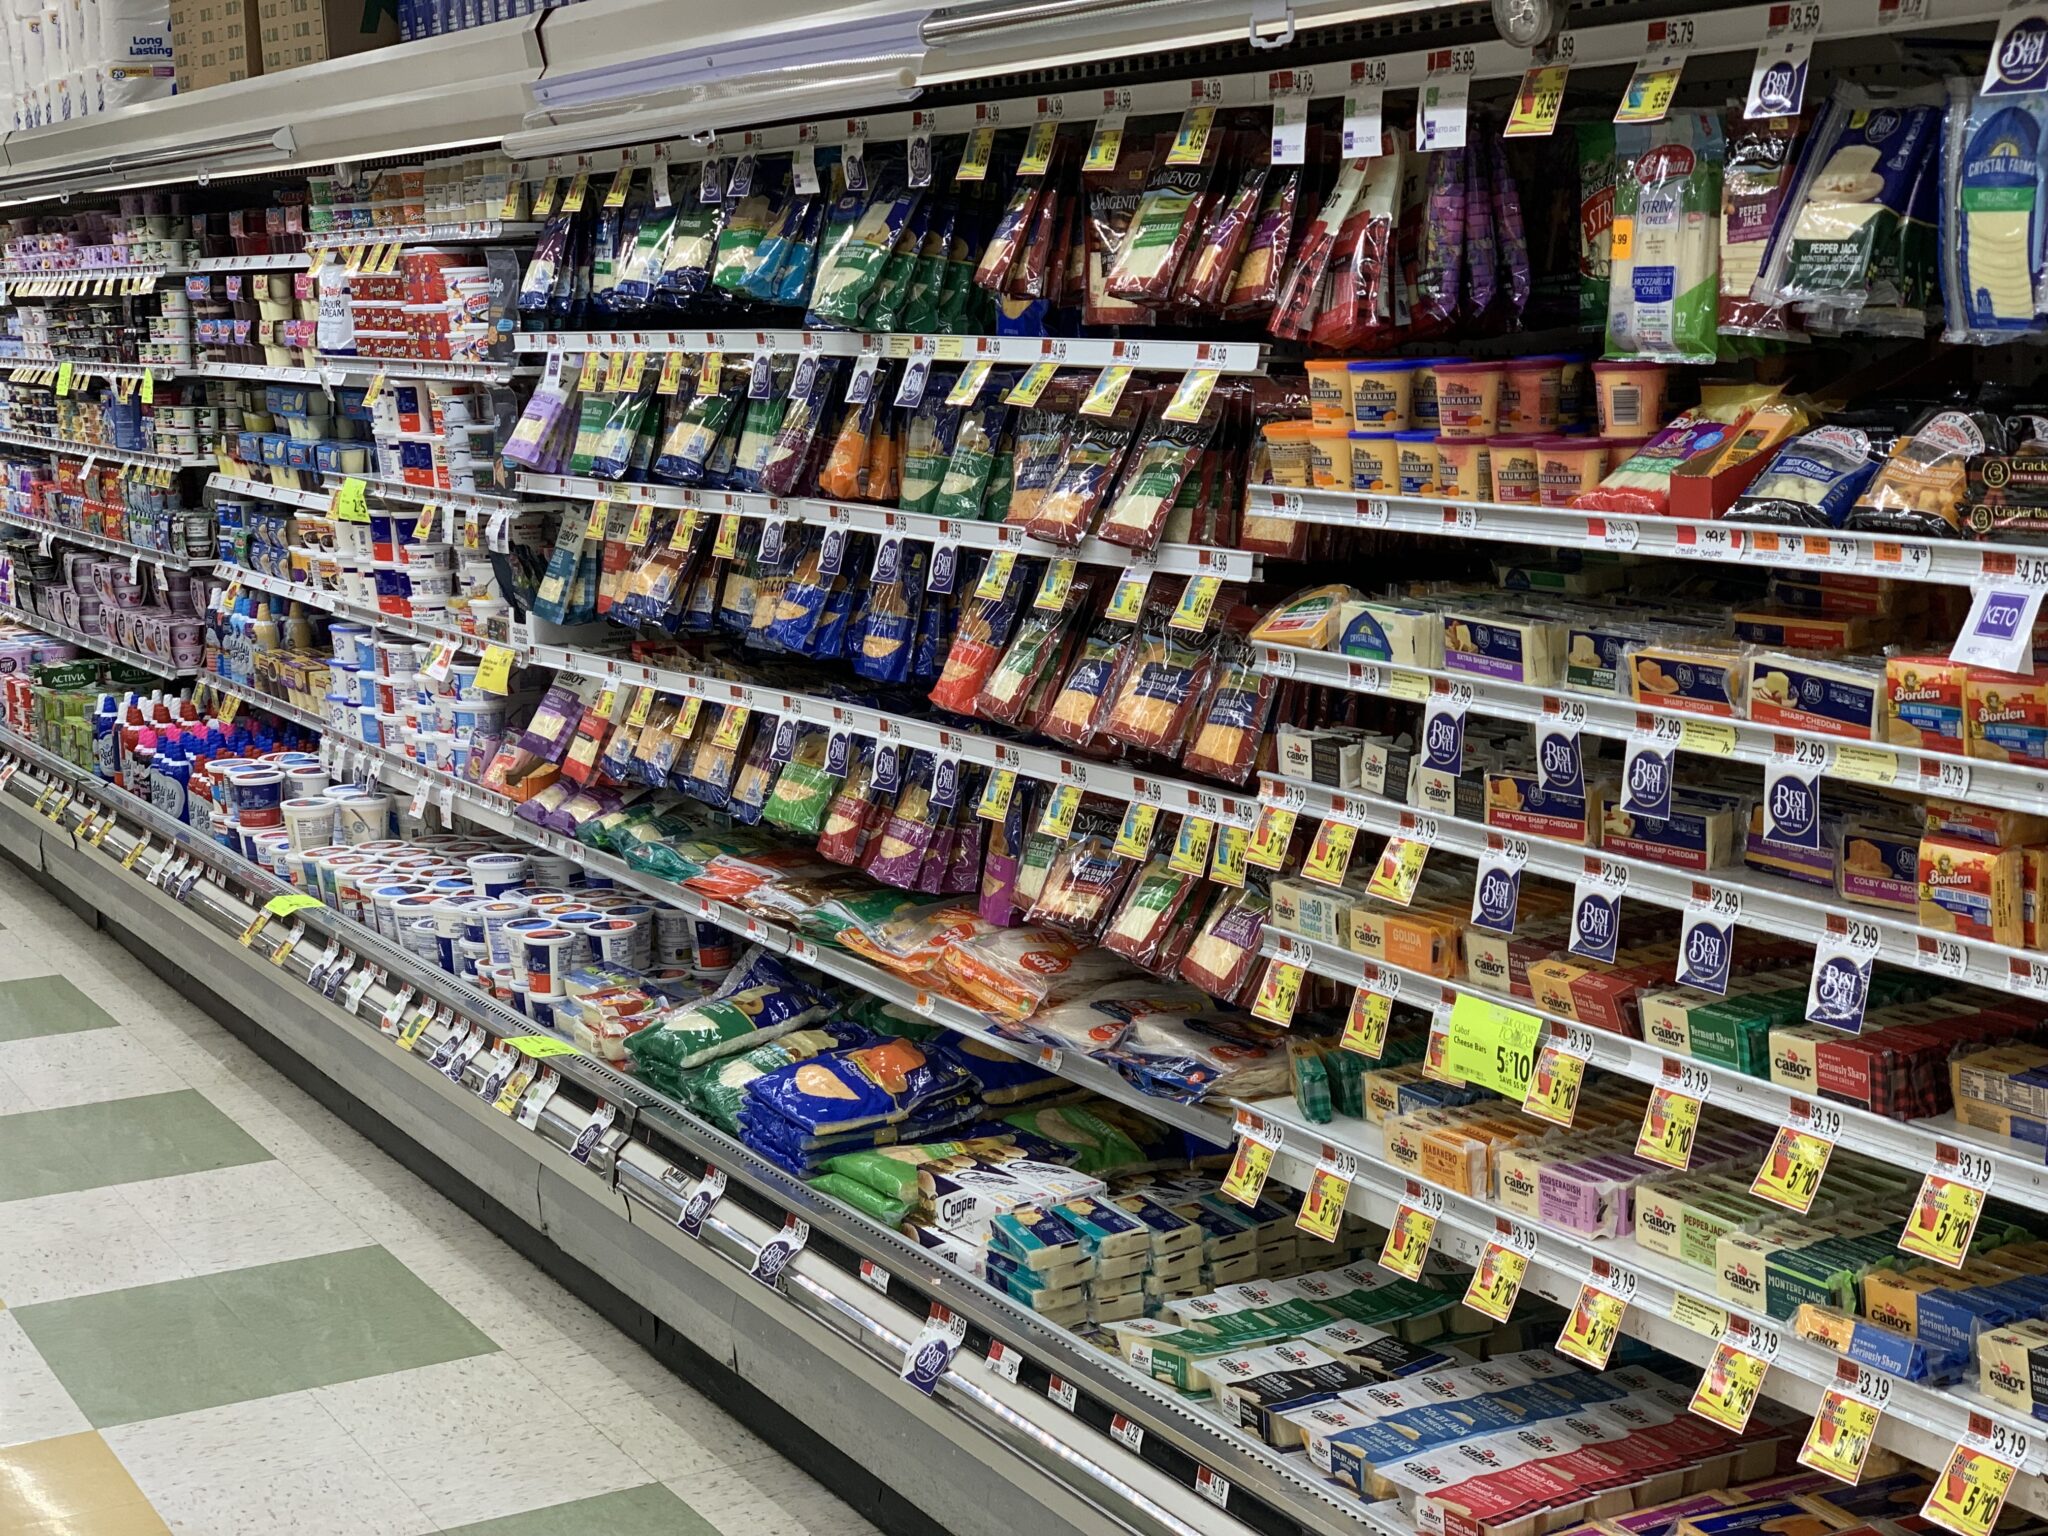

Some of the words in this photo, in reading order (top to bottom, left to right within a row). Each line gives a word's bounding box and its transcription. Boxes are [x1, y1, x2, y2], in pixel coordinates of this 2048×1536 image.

[1788, 6, 1820, 30] $3.59
[133, 36, 163, 48] Long
[1667, 21, 1694, 45] $5.79
[129, 45, 172, 56] Lasting
[1366, 62, 1386, 82] $4.49
[1452, 51, 1475, 72] $5.99
[1968, 158, 2007, 178] CRYSTAL
[2009, 158, 2036, 176] FARMS
[1739, 204, 1767, 217] PEPPER
[1743, 215, 1762, 227] JACK
[1810, 243, 1839, 253] PEPPER
[1840, 244, 1858, 253] JACK
[1633, 277, 1670, 286] MOZZARELLA
[1642, 287, 1663, 295] CHEESE
[1676, 312, 1686, 327] 12
[1354, 392, 1397, 400] KAUKAUNA
[1994, 506, 2031, 518] Cracker
[1983, 606, 2019, 627] KETO
[1456, 653, 1472, 662] EXTRA
[1473, 656, 1489, 666] SHARP
[1490, 660, 1513, 671] CHEDDAR
[51, 673, 86, 684] ACTIVIA
[1150, 673, 1174, 682] SHARP
[1593, 671, 1614, 679] PEPPER
[1450, 682, 1472, 703] $2.99
[1895, 688, 1940, 701] Borden
[1561, 702, 1584, 723] $2.99
[1663, 698, 1683, 707] SHARP
[1685, 701, 1714, 712] CHEDDAR
[1979, 708, 2026, 723] Borden
[1655, 717, 1681, 740] $2.99
[1780, 710, 1803, 726] SHARP
[1805, 715, 1842, 732] CHEDDAR
[1796, 741, 1825, 765] $2.99
[1942, 764, 1963, 785] $3.79
[1286, 789, 1304, 806] $3.19
[1425, 786, 1451, 800] CABOT
[1774, 784, 1807, 818] BEST
[1346, 801, 1365, 821] $3.19
[1496, 812, 1510, 821] NEW
[1511, 814, 1525, 823] YORK
[1527, 816, 1546, 826] SHARP
[1548, 819, 1578, 830] CHEDDAR
[1415, 818, 1436, 839] $3.19
[1503, 840, 1527, 861] $2.99
[1612, 838, 1626, 848] NEW
[1627, 841, 1644, 850] YORK
[1645, 844, 1666, 855] SHARP
[1667, 848, 1699, 861] CHEDDAR
[1602, 862, 1627, 886] $2.99
[1853, 877, 1879, 888] COLBY
[1881, 881, 1898, 891] AND
[1928, 870, 1972, 885] Borden
[1275, 902, 1296, 917] CABOT
[1712, 888, 1739, 914] $2.99
[1354, 929, 1381, 945] CABOT
[1392, 929, 1422, 947] GOUDA
[1848, 921, 1878, 948] $2.99
[1292, 940, 1311, 962] $3.19
[1690, 929, 1722, 962] BEST
[1939, 942, 1961, 963] $2.99
[1475, 959, 1505, 973] CABOT
[1379, 968, 1399, 991] $3.19
[1541, 995, 1572, 1012] CABOT
[1455, 1024, 1470, 1035] Cabot
[1568, 1028, 1592, 1052] $3.19
[1652, 1025, 1685, 1042] CABOT
[1691, 1026, 1714, 1041] Vermont
[1716, 1032, 1735, 1048] Sharp
[1454, 1036, 1473, 1049] Cheese
[1474, 1042, 1487, 1054] Bars
[1497, 1046, 1506, 1073] 5
[1510, 1051, 1530, 1083] $10
[1775, 1057, 1812, 1077] CABOT
[1818, 1059, 1848, 1075] Seriously
[1848, 1068, 1867, 1083] Sharp
[1500, 1075, 1512, 1087] SAVE
[1682, 1066, 1708, 1092] $3.19
[1370, 1092, 1395, 1110] CABOT
[1812, 1106, 1840, 1134] $3.19
[1335, 1150, 1356, 1173] $3.19
[1391, 1142, 1418, 1161] CABOT
[1422, 1142, 1458, 1166] HABANERO
[1007, 1161, 1071, 1176] Cooper
[1959, 1151, 1992, 1182] $3.19
[955, 1172, 1019, 1187] Cooper
[1503, 1171, 1535, 1194] CABOT
[1539, 1173, 1582, 1197] HORSERADISH
[1786, 1162, 1819, 1197] 5/$10
[1421, 1185, 1443, 1211] $3.19
[942, 1197, 977, 1223] Cooper
[1643, 1213, 1676, 1233] CABOT
[1683, 1214, 1708, 1232] PEPPER
[1709, 1223, 1728, 1238] JACK
[1936, 1212, 1971, 1249] 5/$10
[1512, 1222, 1535, 1251] $3.19
[1610, 1265, 1635, 1294] $3.19
[1724, 1271, 1760, 1292] CABOT
[1768, 1275, 1807, 1296] MONTEREY
[1808, 1288, 1827, 1306] JACK
[1871, 1309, 1912, 1332] CABOT
[1920, 1317, 1951, 1335] Seriously
[1750, 1324, 1778, 1354] $3.19
[1806, 1331, 1839, 1349] CABOT
[1275, 1346, 1307, 1366] CABOT
[1852, 1344, 1881, 1363] Seriously
[1882, 1355, 1901, 1371] Sharp
[1218, 1358, 1252, 1377] CABOT
[1422, 1376, 1458, 1398] CABOT
[1858, 1370, 1890, 1400] $3.19
[1990, 1370, 2025, 1391] CABOT
[1368, 1388, 1404, 1409] CABOT
[1312, 1409, 1349, 1428] CABOT
[1124, 1424, 1141, 1444] $4.29
[1518, 1430, 1558, 1453] CABOT
[1993, 1425, 2026, 1458] $3.19
[1459, 1445, 1502, 1468] CABOT
[1955, 1453, 1979, 1471] WEEKLY
[1404, 1462, 1448, 1486] CABOT
[1950, 1465, 1978, 1485] SPECIALS
[1963, 1486, 2000, 1524] 5/$10
[1420, 1509, 1442, 1524] CABOT
